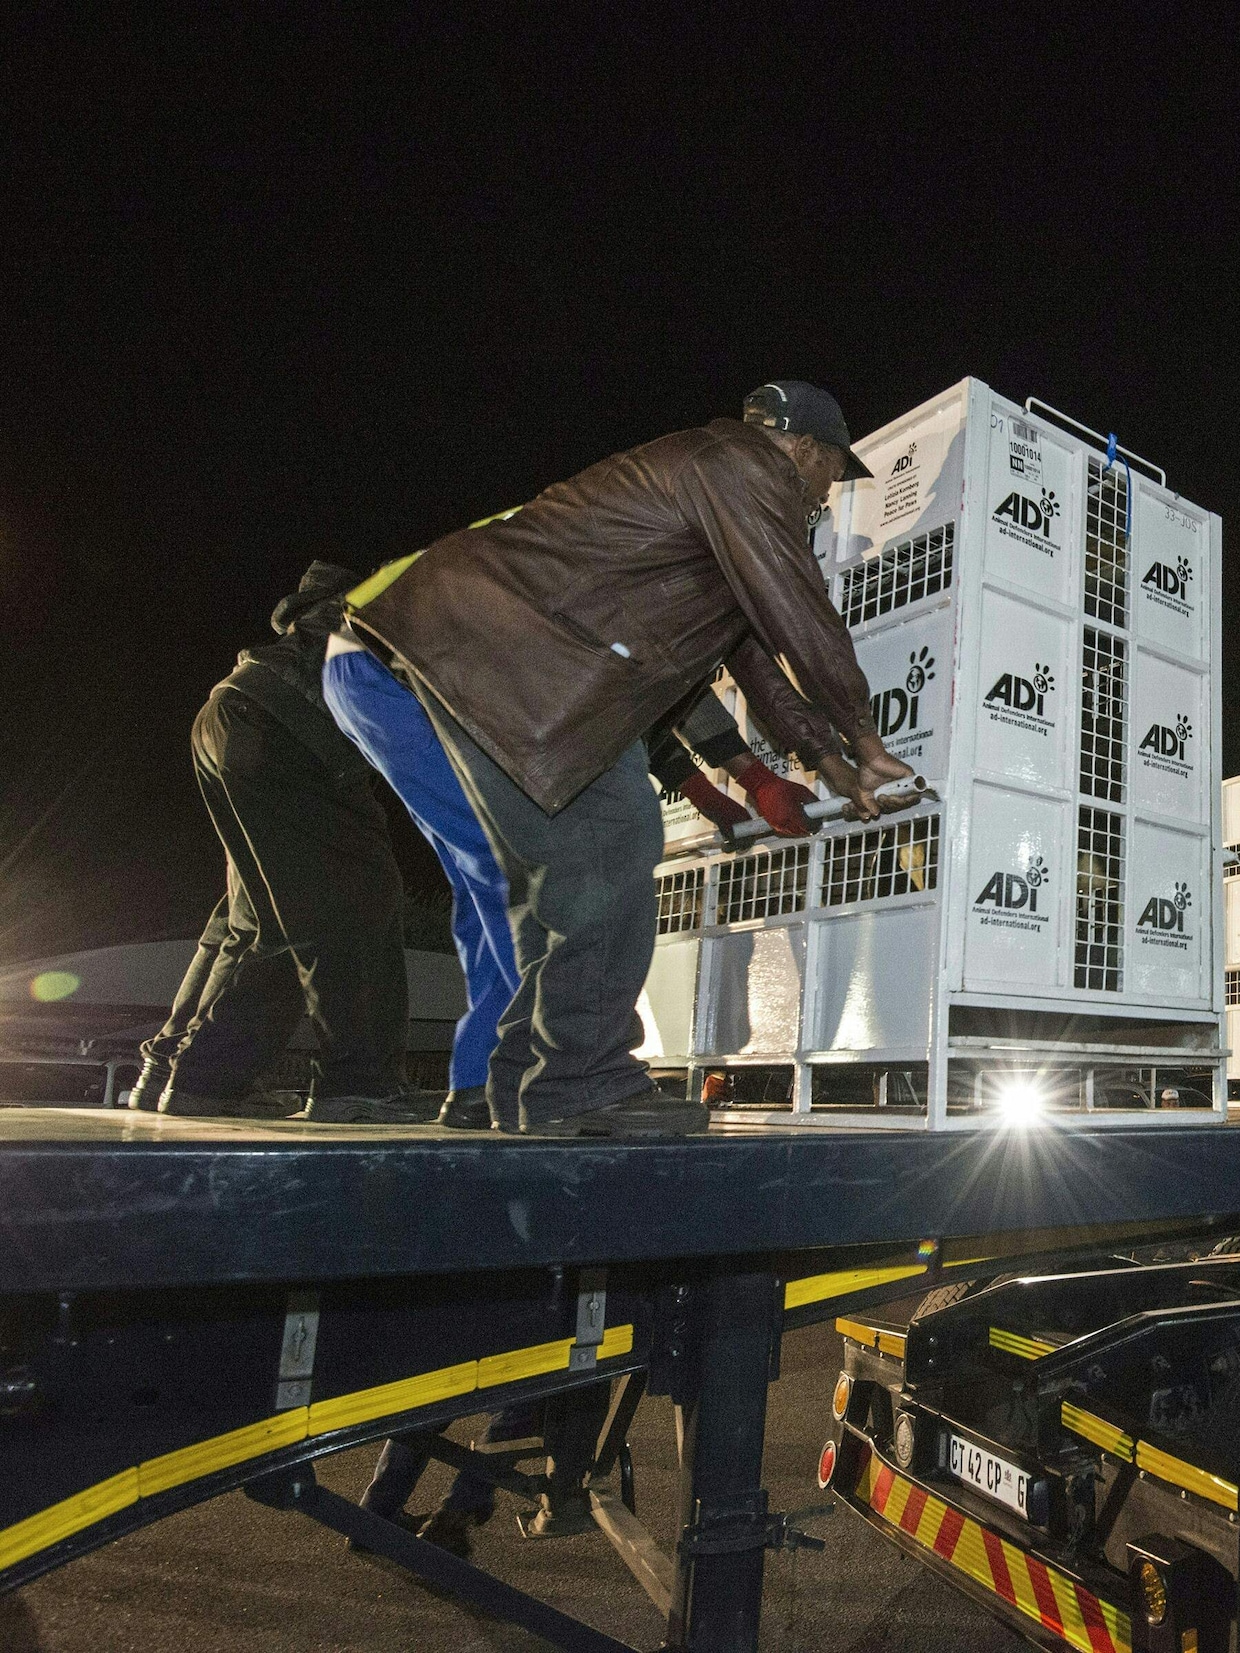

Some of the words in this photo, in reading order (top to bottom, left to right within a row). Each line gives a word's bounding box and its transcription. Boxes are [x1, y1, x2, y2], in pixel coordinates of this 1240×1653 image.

[1009, 441, 1041, 462] 10001014
[992, 515, 1008, 526] Animal
[1009, 522, 1032, 537] Defenders
[1034, 535, 1061, 550] International
[999, 527, 1054, 558] ad-international.org
[982, 702, 1000, 712] Animal
[1001, 707, 1025, 719] Defenders
[1026, 714, 1055, 728] International
[990, 713, 1047, 736] ad-international.org
[750, 737, 765, 754] the
[782, 755, 800, 774] site
[972, 906, 990, 914] Animal
[992, 909, 1017, 918] Defenders
[1018, 912, 1049, 922] International
[980, 916, 1040, 932] ad-international.org
[951, 1440, 965, 1473] CT
[968, 1449, 982, 1484] 42
[987, 1459, 1001, 1493] CP
